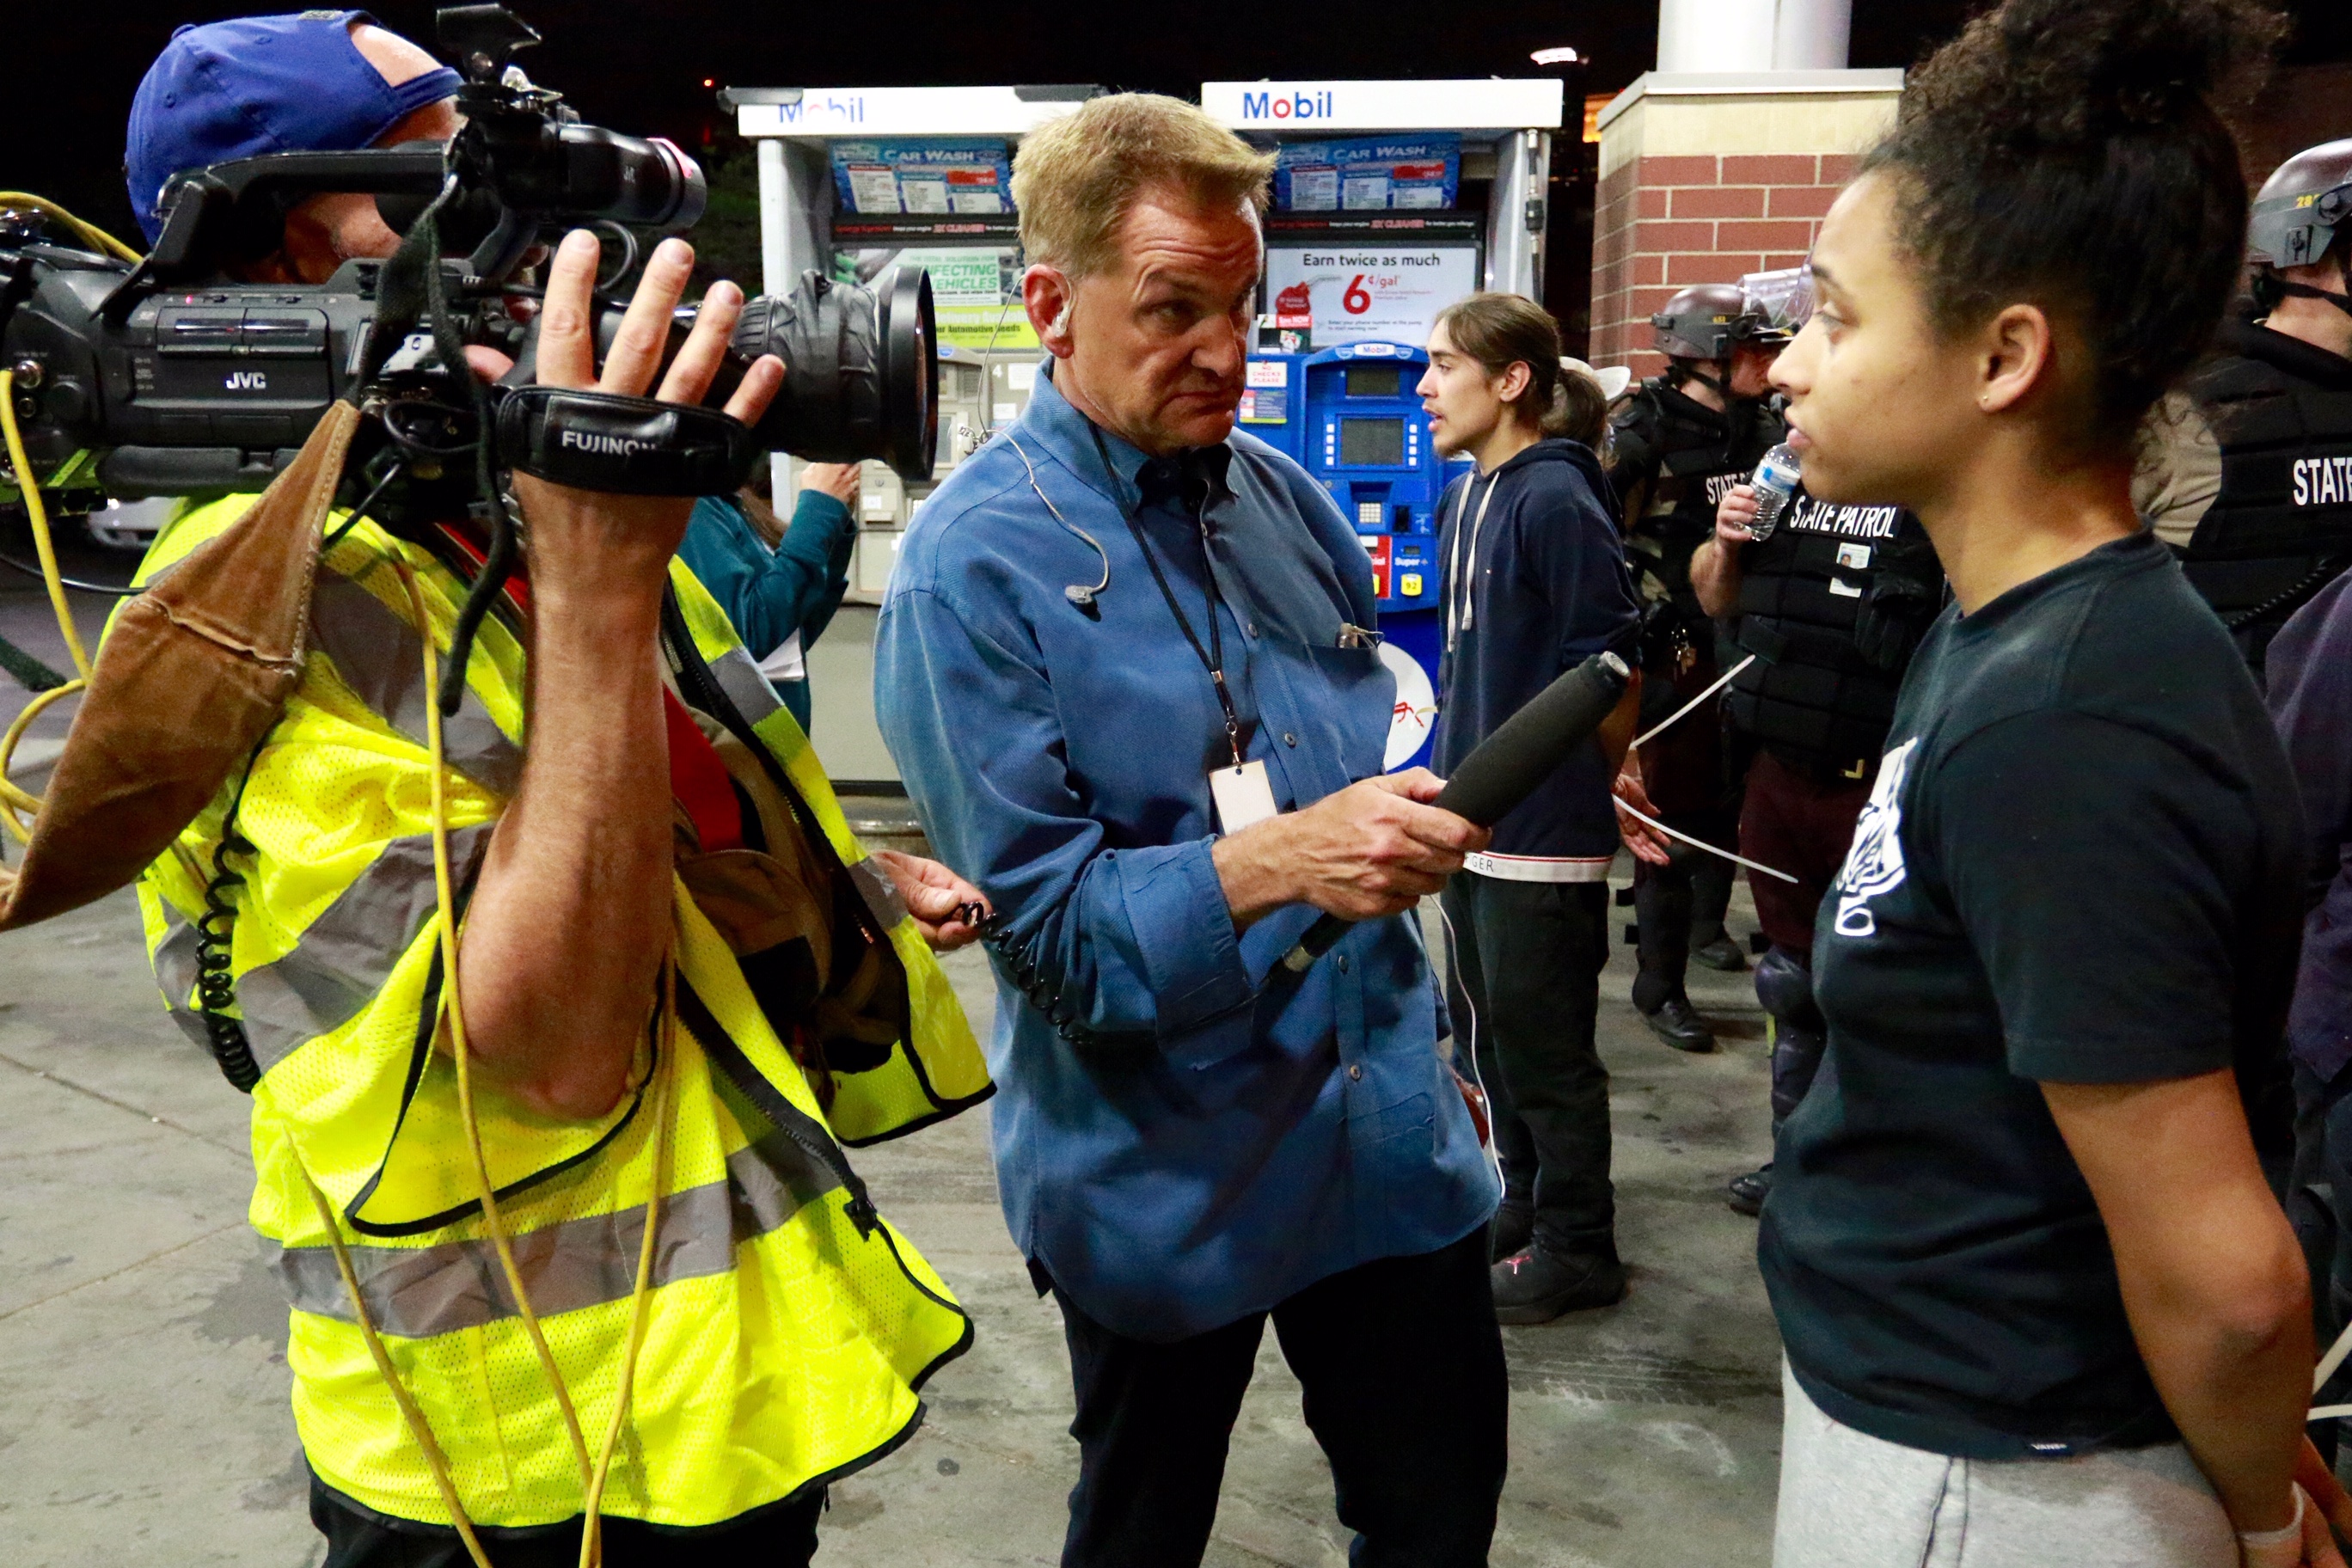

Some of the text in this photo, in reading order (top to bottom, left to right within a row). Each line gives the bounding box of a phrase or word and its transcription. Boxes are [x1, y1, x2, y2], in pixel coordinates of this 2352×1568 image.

[1243, 91, 1332, 119] Mobil
[884, 150, 922, 160] CAR
[924, 150, 975, 161] WASH
[1333, 145, 1427, 159] CAR WASH
[1302, 253, 1441, 266] Earn twice as much
[926, 264, 996, 276] NFECTING
[948, 324, 994, 334] Automotive
[992, 364, 1003, 378] 4
[226, 371, 266, 389] JVC
[1833, 505, 1896, 538] PATROL
